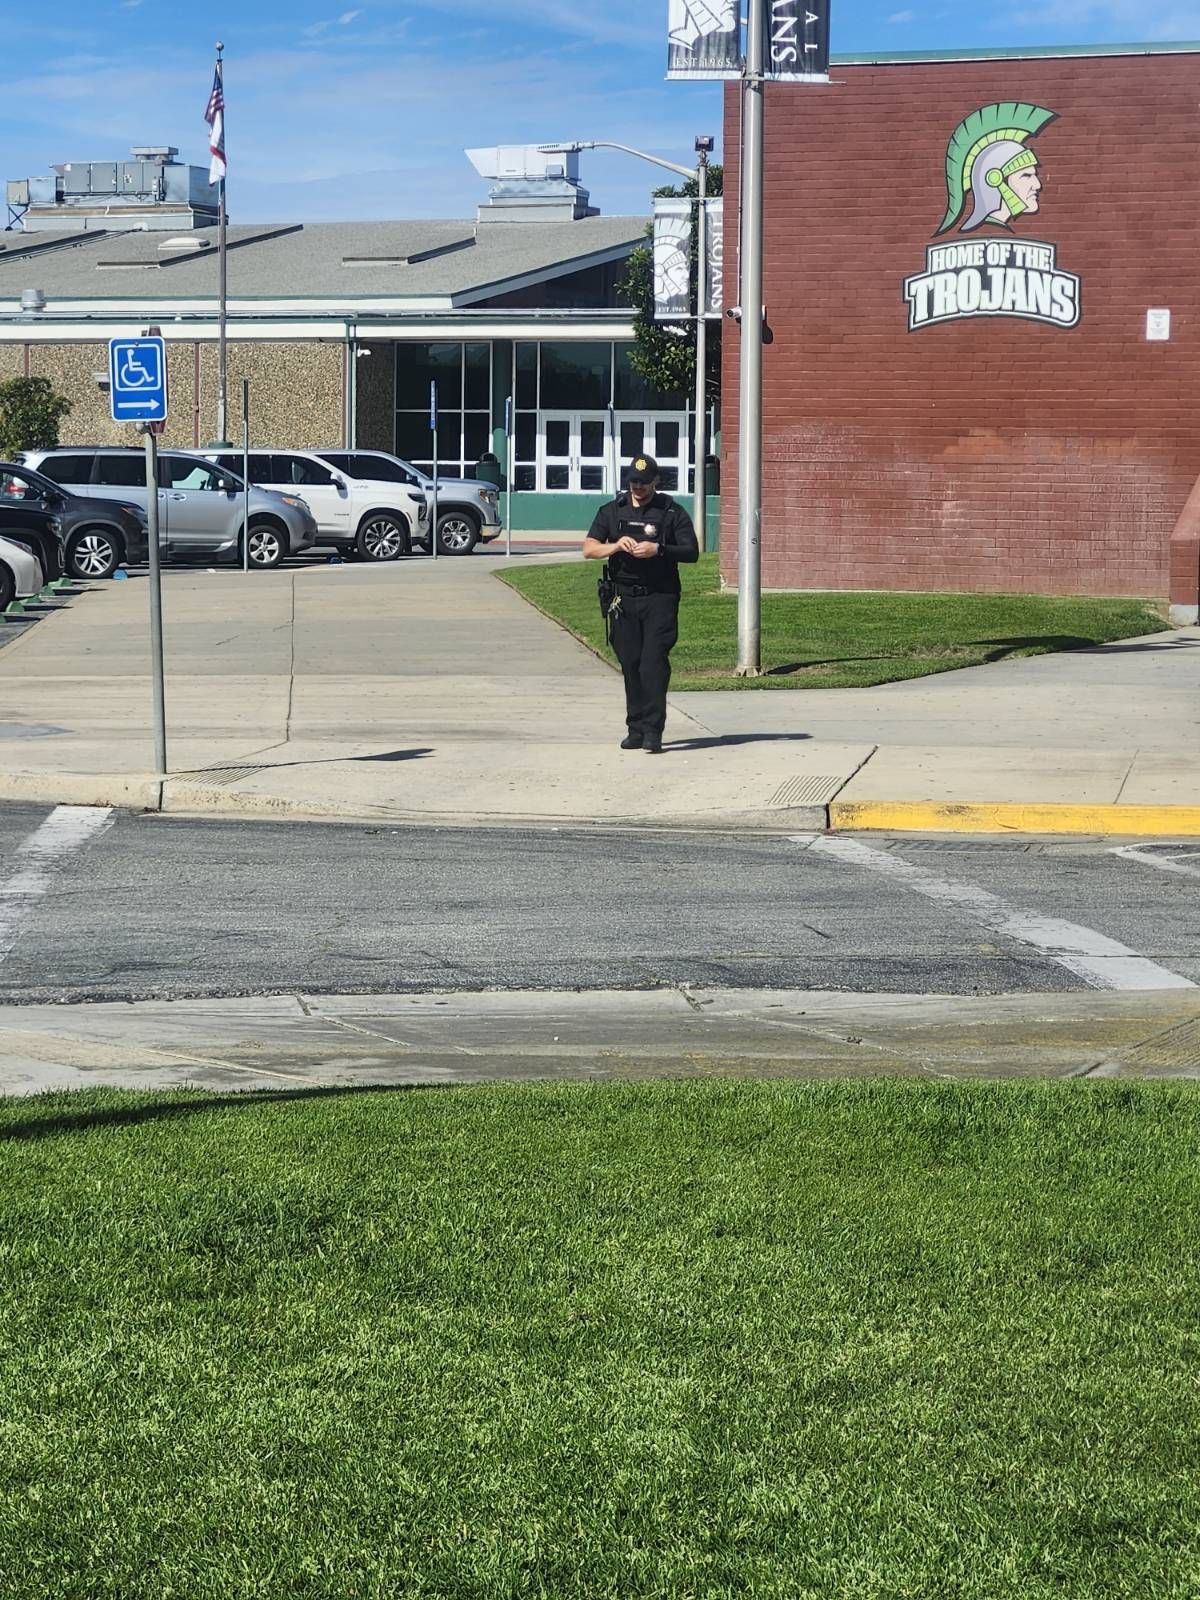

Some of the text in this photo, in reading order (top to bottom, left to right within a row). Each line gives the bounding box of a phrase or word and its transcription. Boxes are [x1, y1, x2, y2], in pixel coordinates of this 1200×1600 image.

[932, 243, 1051, 272] HOME OF THE
[909, 267, 1075, 323] TROJANS
